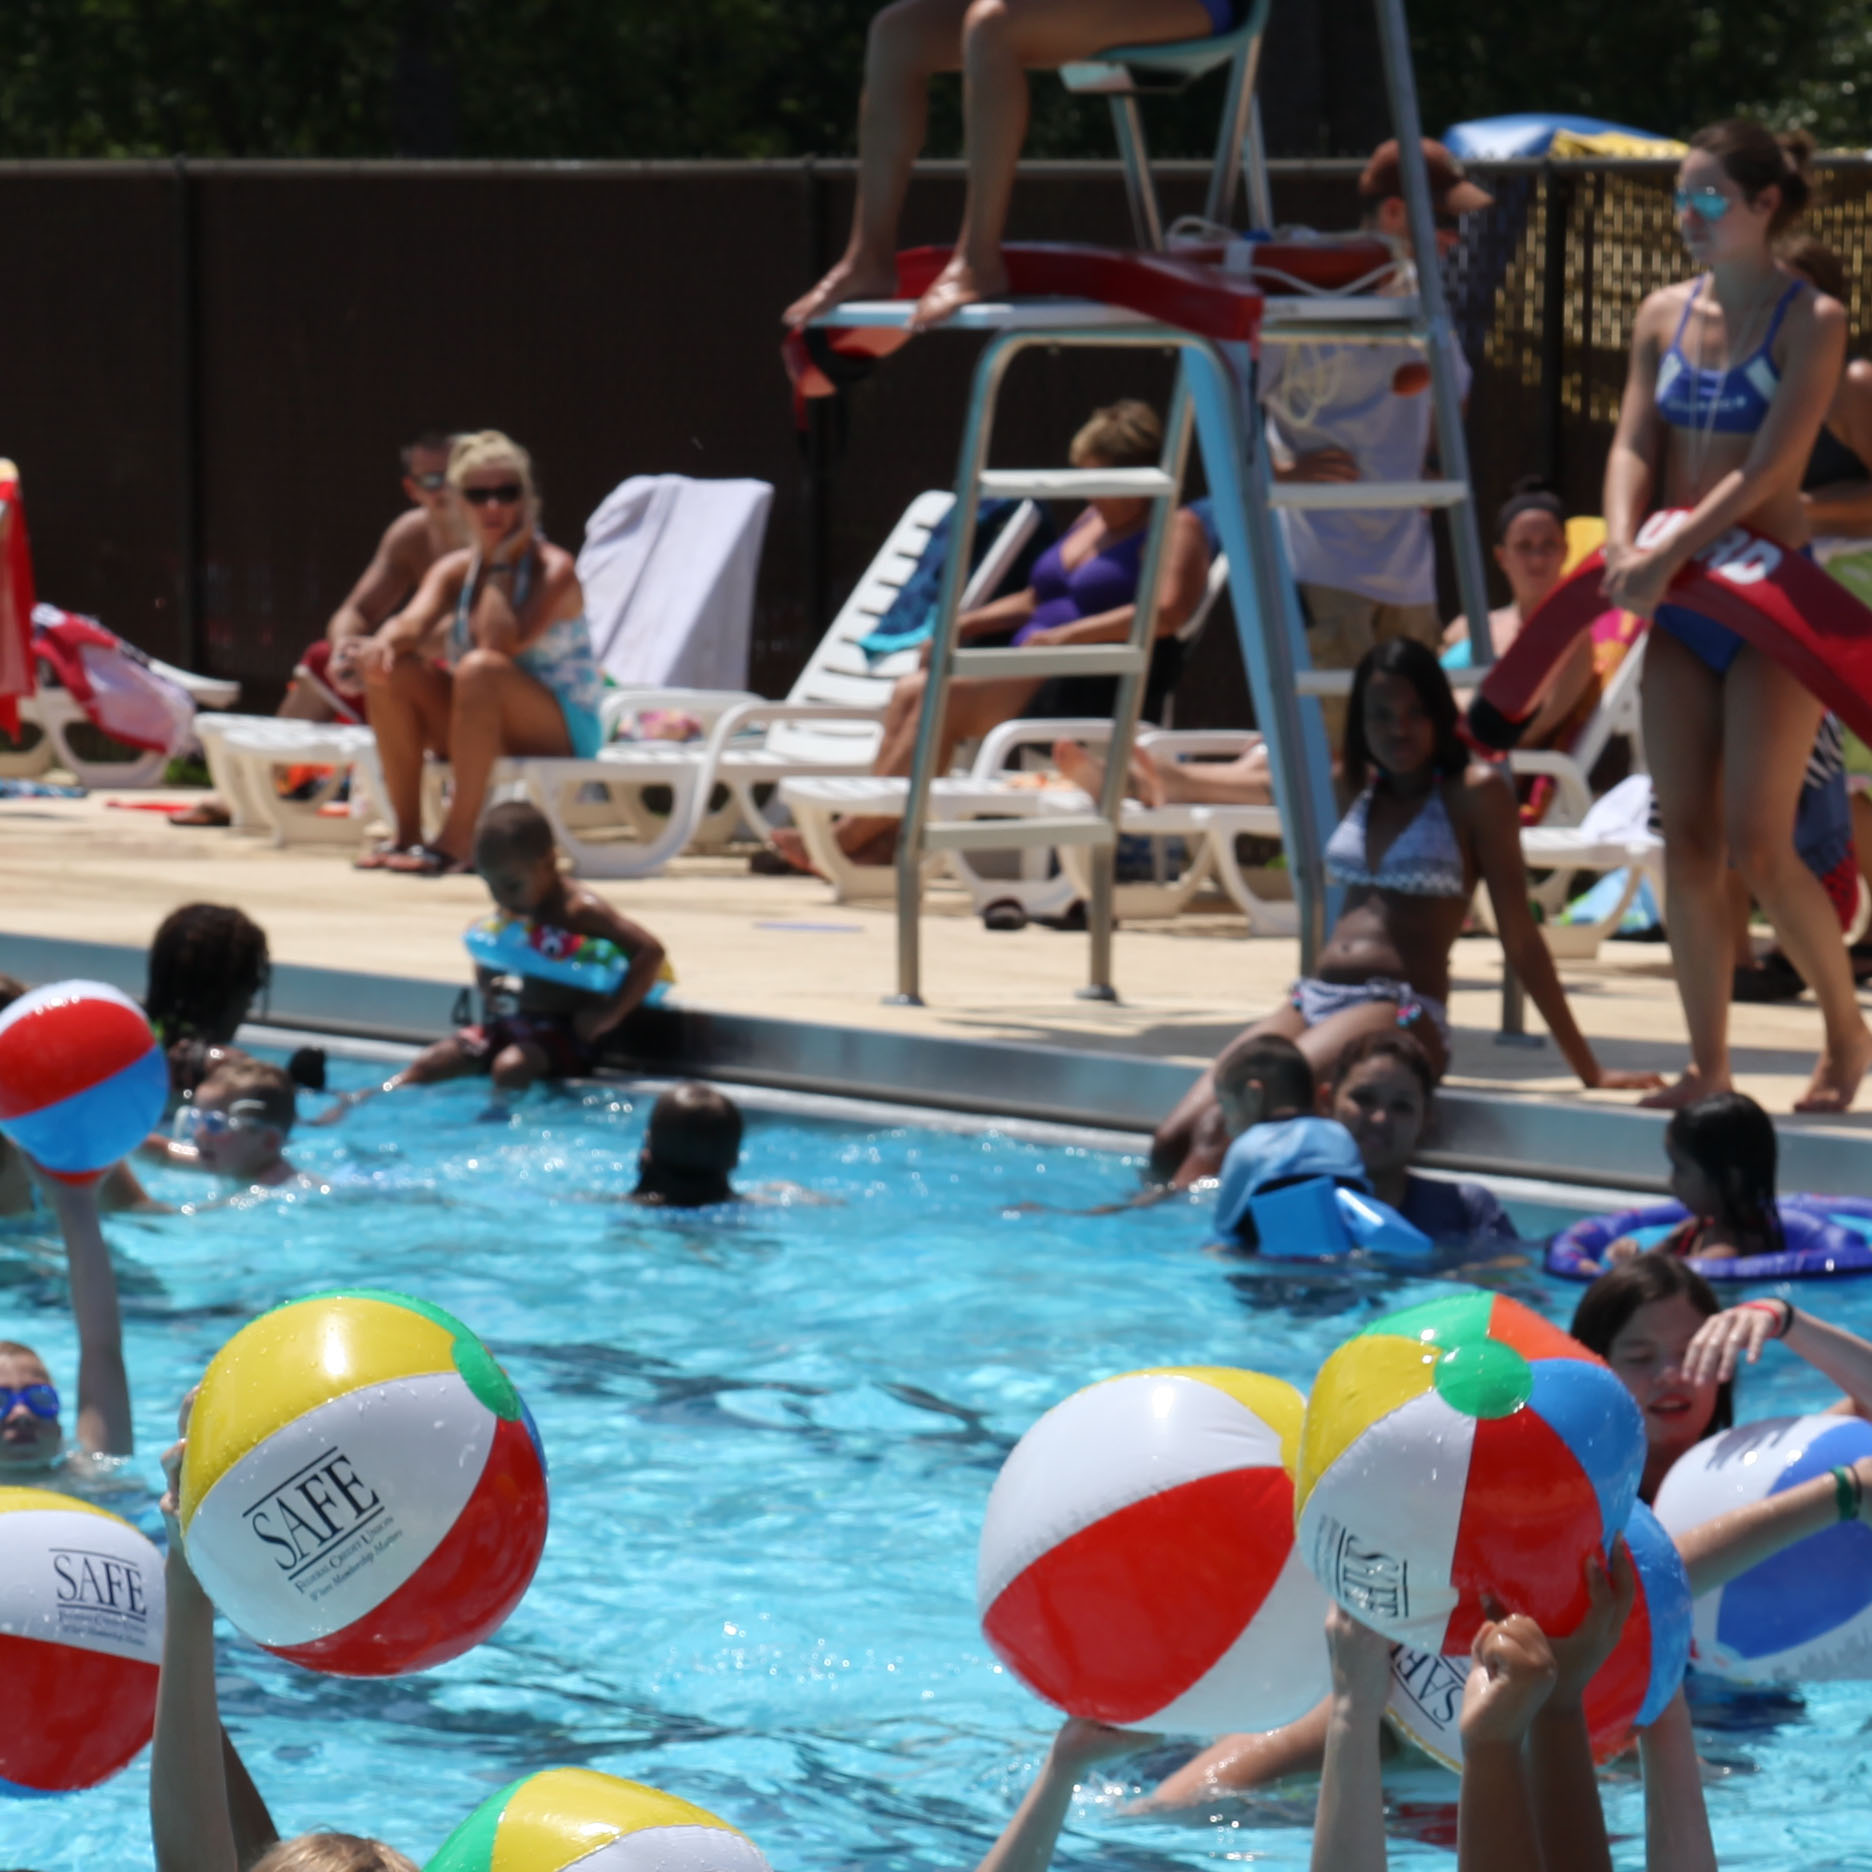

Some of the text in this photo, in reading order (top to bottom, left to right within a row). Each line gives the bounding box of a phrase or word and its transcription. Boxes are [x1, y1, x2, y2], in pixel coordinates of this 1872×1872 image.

[252, 1455, 380, 1571] SAFE
[53, 1554, 147, 1616] SAFE
[1390, 1643, 1465, 1723] SAF
